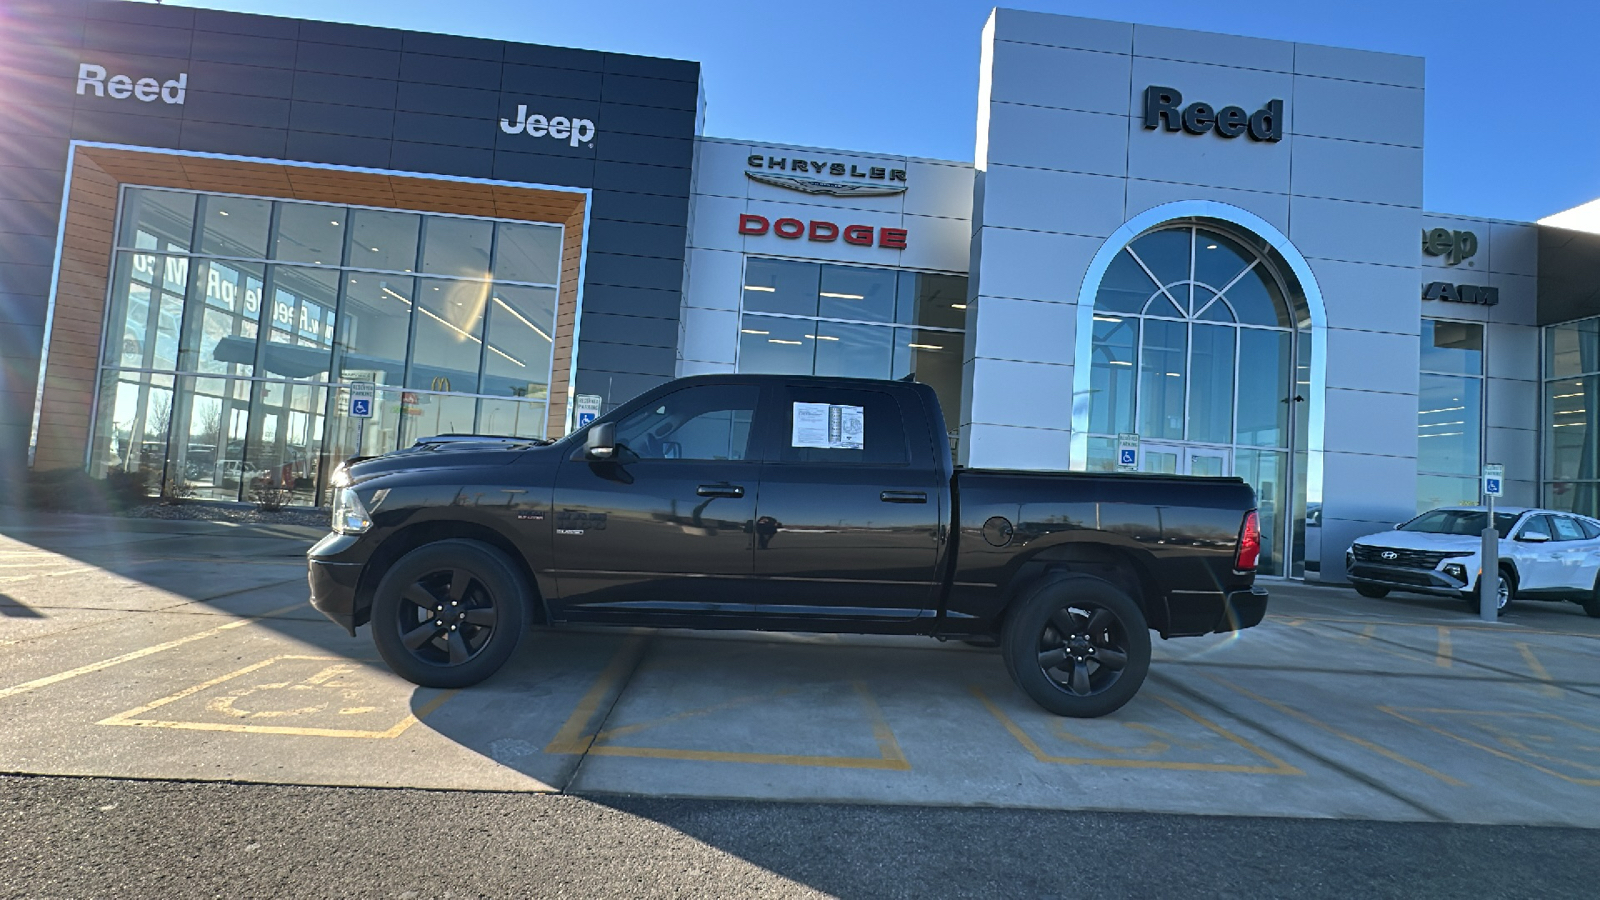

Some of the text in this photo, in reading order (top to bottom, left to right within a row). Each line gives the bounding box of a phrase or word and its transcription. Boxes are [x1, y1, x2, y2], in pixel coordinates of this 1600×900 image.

[76, 63, 187, 105] Reed
[499, 103, 595, 148] Jeep
[1143, 84, 1284, 143] Reed
[747, 154, 907, 182] CHRYSLER
[738, 213, 908, 251] DODGE
[1422, 227, 1478, 266] ep
[1422, 281, 1499, 306] AM
